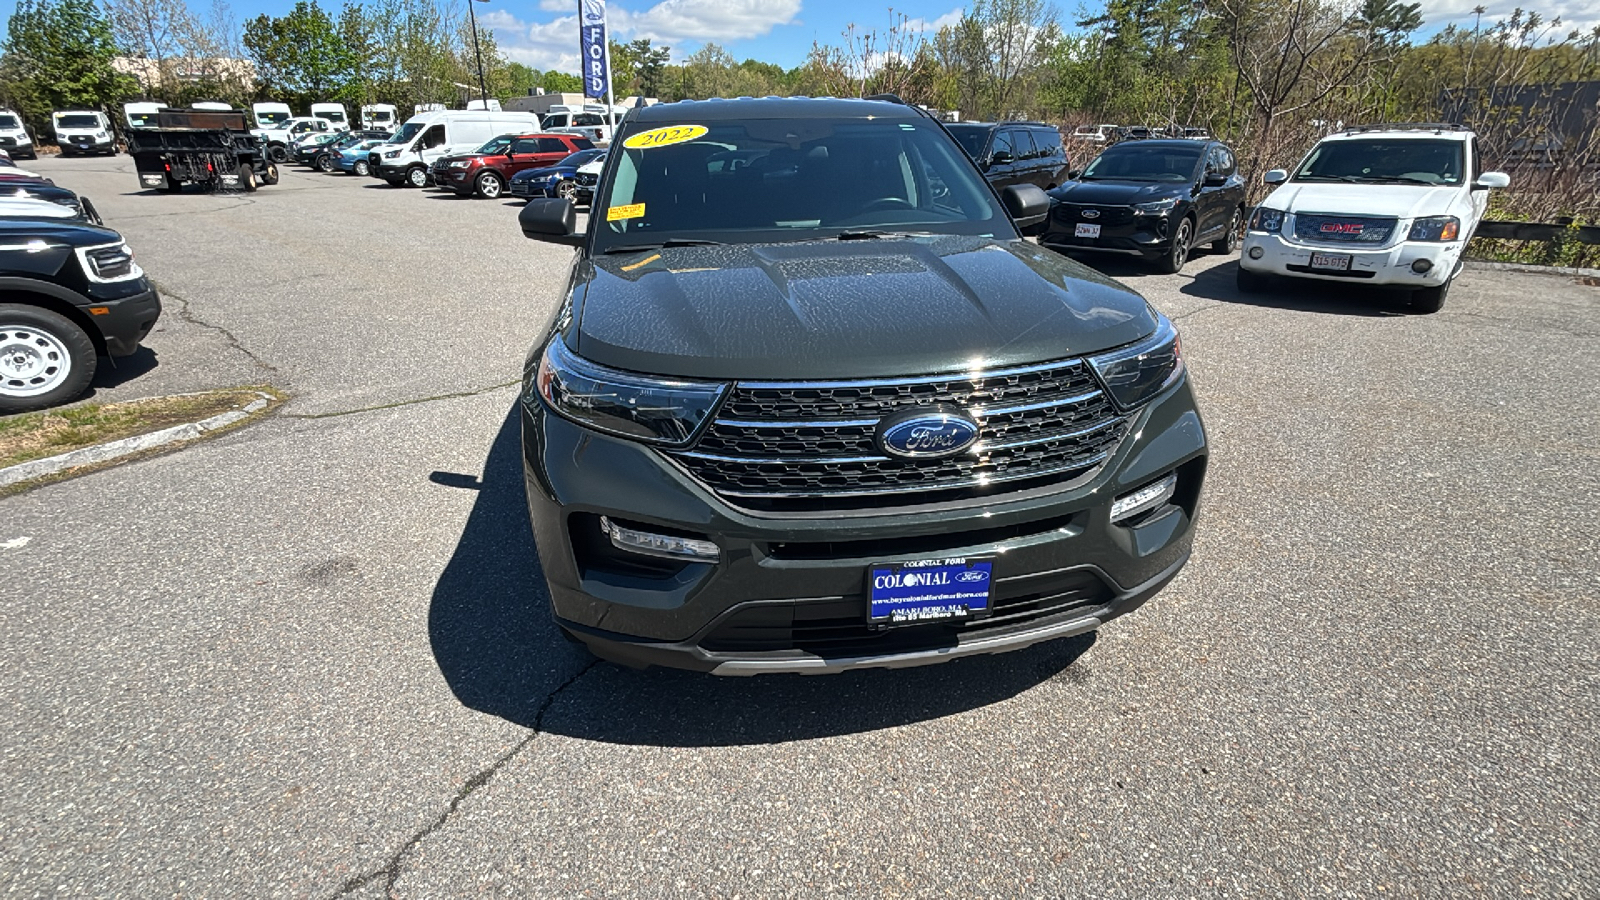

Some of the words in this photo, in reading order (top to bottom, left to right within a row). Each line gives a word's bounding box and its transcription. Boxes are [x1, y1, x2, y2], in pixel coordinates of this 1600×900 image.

[590, 28, 603, 91] FORD
[641, 127, 694, 146] 2022
[1321, 222, 1364, 234] GMC
[905, 425, 958, 449] Ford
[903, 559, 943, 568] COLONIAL
[944, 557, 966, 566] FORD
[874, 571, 951, 589] COLONIAL
[919, 611, 951, 619] Marlboro
[955, 609, 967, 617] MA
